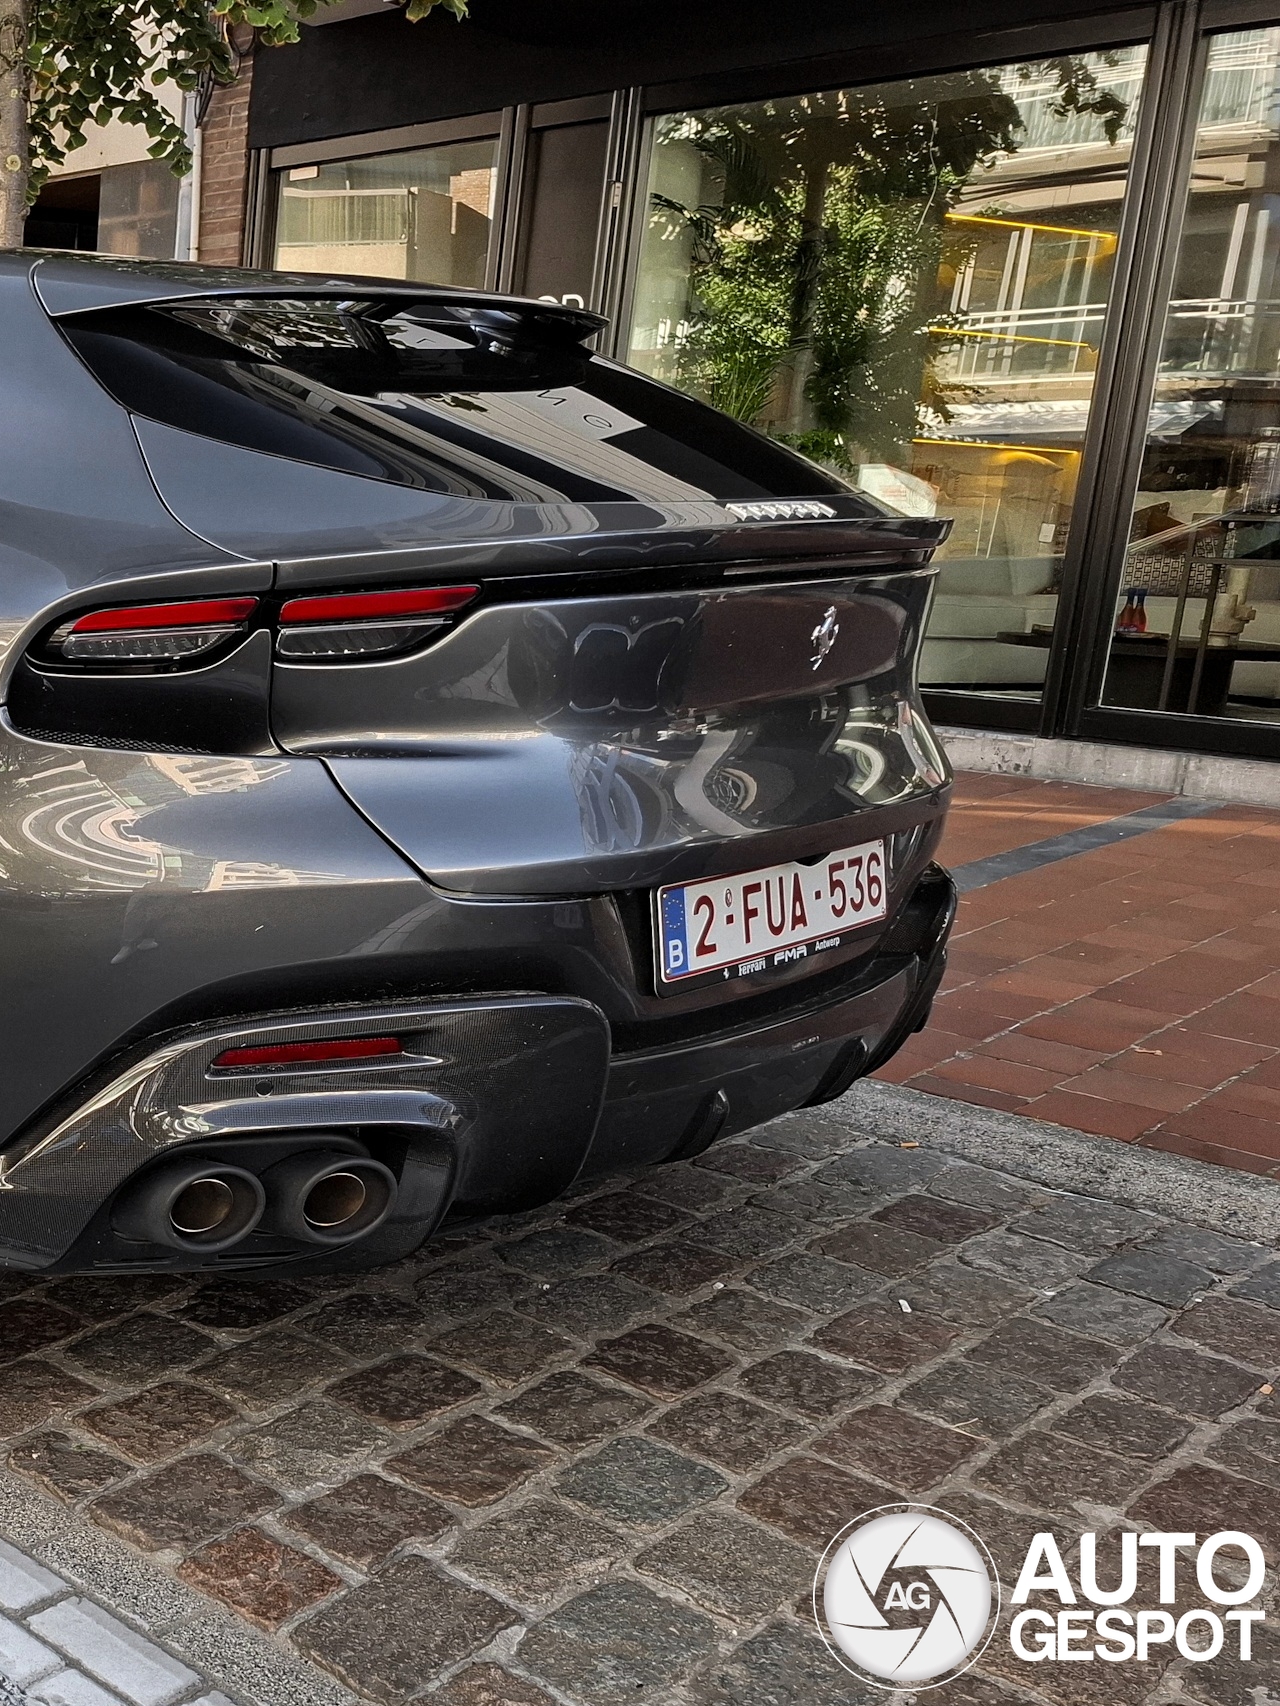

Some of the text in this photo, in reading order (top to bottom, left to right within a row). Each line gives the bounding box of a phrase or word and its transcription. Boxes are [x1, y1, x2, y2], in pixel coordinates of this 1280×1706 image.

[669, 939, 684, 969] B
[738, 937, 840, 976] Ferrari FMA Antwerp
